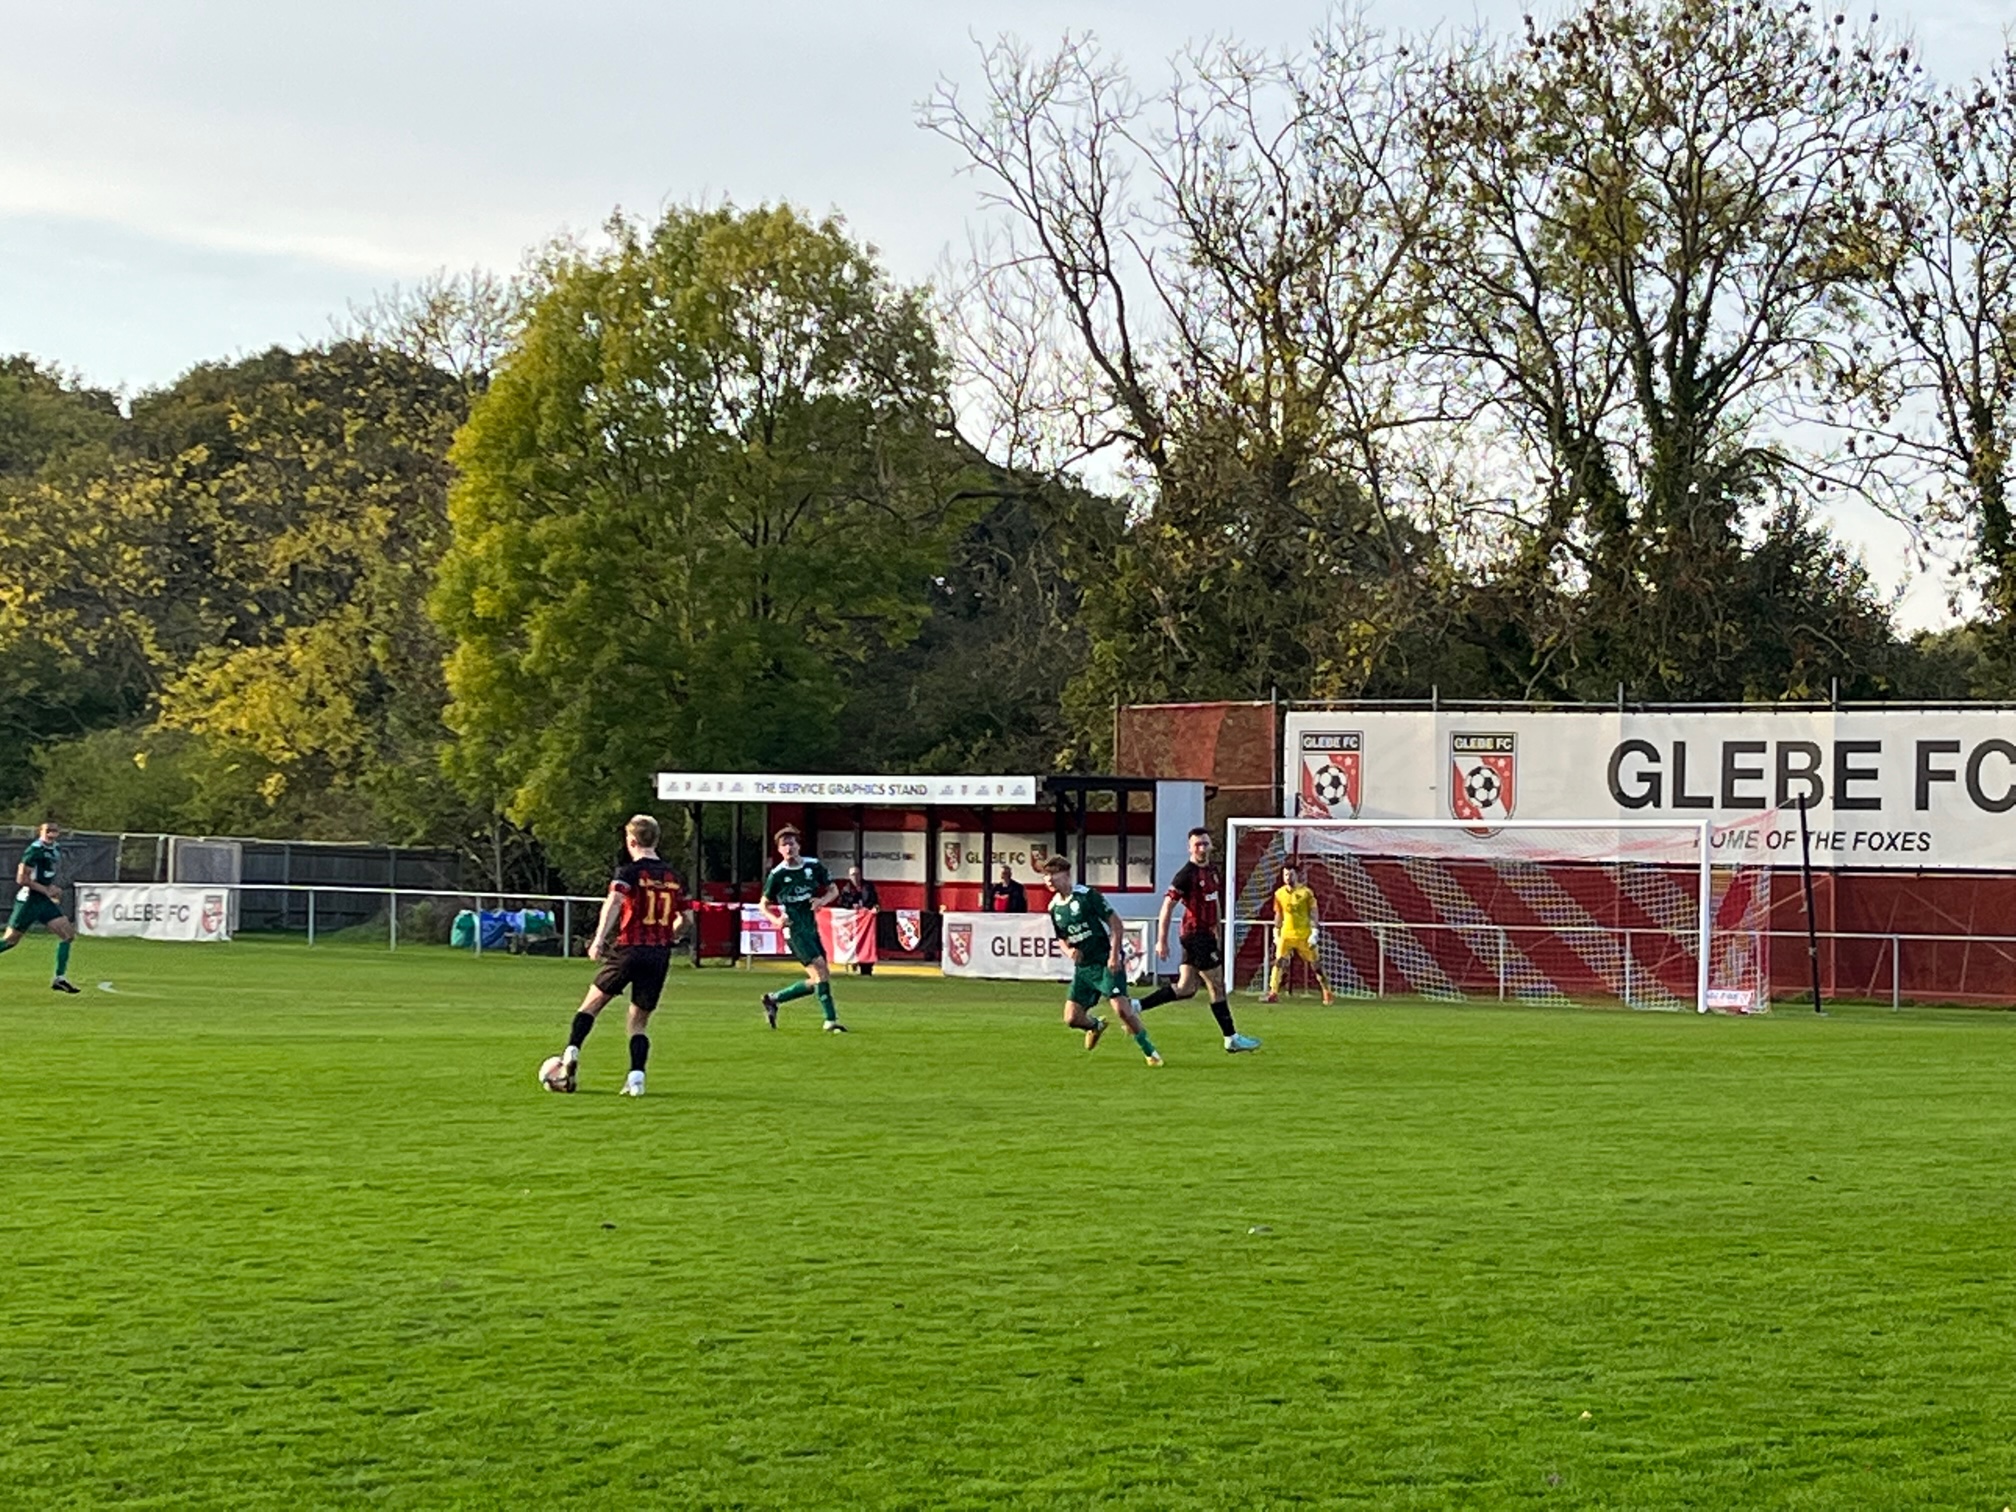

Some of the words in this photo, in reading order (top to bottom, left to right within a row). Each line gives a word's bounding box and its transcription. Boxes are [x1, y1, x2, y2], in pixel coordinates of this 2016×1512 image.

[1303, 736, 1341, 749] GLEBE
[1343, 737, 1359, 749] FC
[1453, 737, 1494, 750] GLEBE
[1496, 738, 1512, 750] FC
[1607, 739, 1882, 810] GLEBE
[1915, 738, 2016, 814] FC
[755, 782, 776, 794] THE
[779, 782, 825, 795] SERVICE
[828, 783, 885, 796] GRAPHICS
[888, 784, 928, 796] STAND
[1767, 830, 1796, 850] OF
[1852, 832, 1931, 851] FOXES
[965, 851, 1006, 865] GLBE
[1009, 852, 1026, 865] FC
[112, 903, 163, 922] GLEBE
[168, 904, 190, 923] FC
[991, 936, 1062, 958] GLEBE
